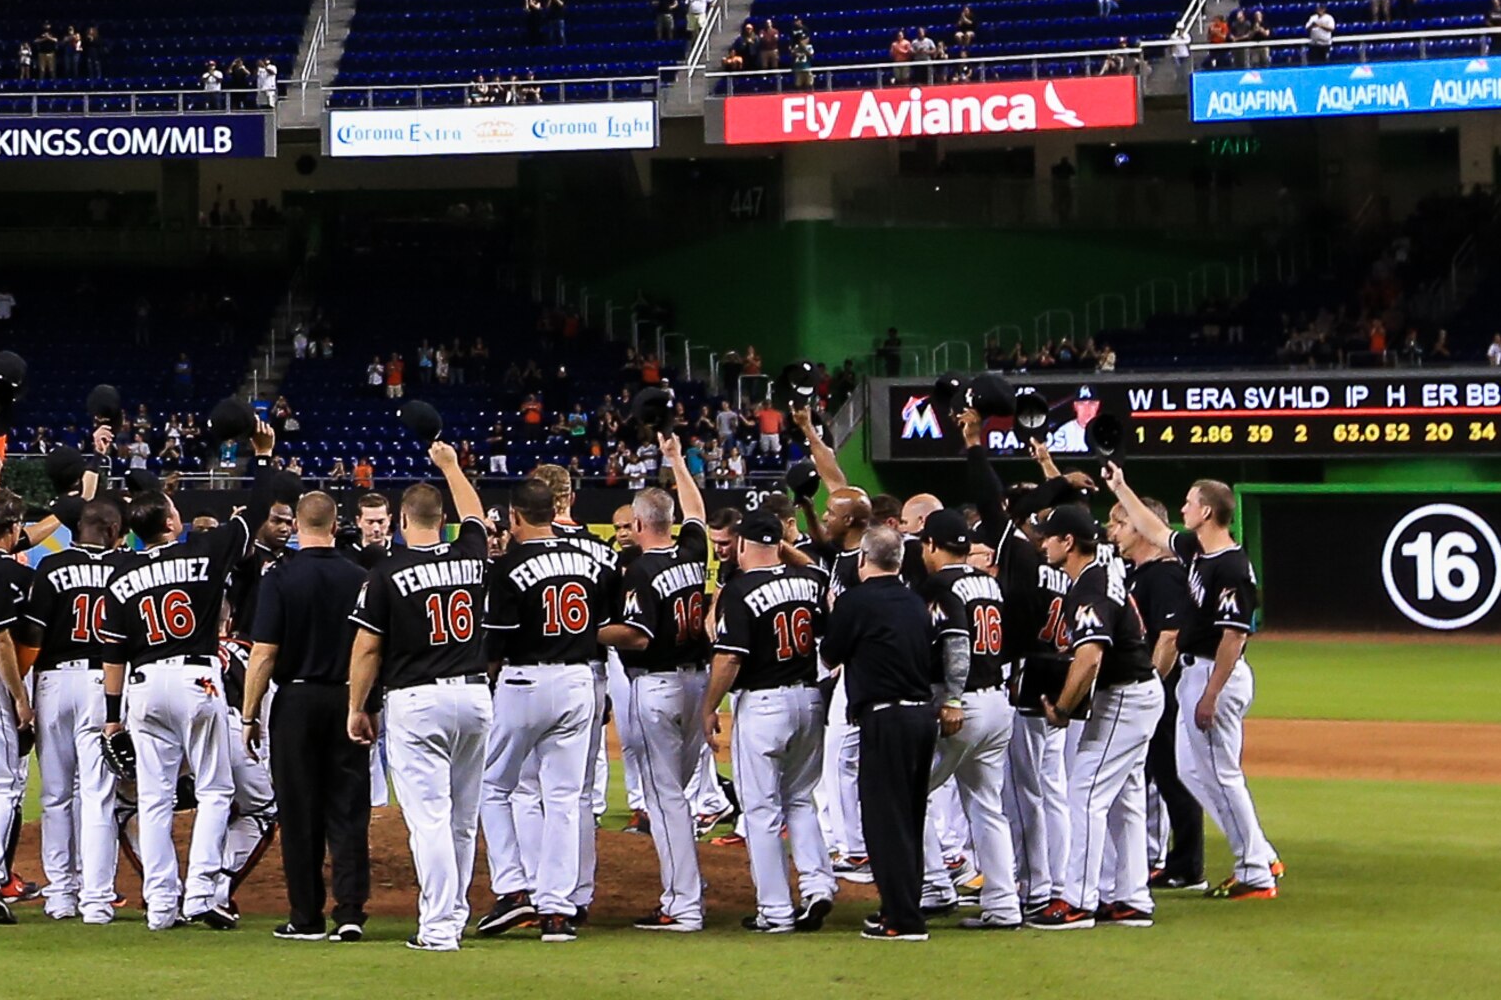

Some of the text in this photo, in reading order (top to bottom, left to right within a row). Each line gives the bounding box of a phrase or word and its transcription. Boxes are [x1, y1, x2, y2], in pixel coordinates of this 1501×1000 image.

[782, 88, 1037, 139] Fly Avianca
[1206, 87, 1298, 117] AQUAFINA
[1315, 81, 1410, 113] AQUAFINA
[336, 124, 404, 145] Corona
[531, 118, 597, 140] Corona
[730, 186, 764, 218] 447
[1128, 383, 1500, 410] W L ERA SV HLD IP H ER BB
[1135, 422, 1497, 443] 1 4 2.86 39 2 63.0 52 20 34
[109, 557, 210, 604] FERNANDEZ
[508, 551, 602, 592] FERNANDEZ
[1401, 530, 1481, 601] 16
[138, 589, 197, 646] 16
[426, 588, 475, 646] 16
[542, 581, 589, 636] 16
[674, 590, 704, 645] 16
[973, 604, 1002, 656] 16
[773, 606, 813, 662] 16
